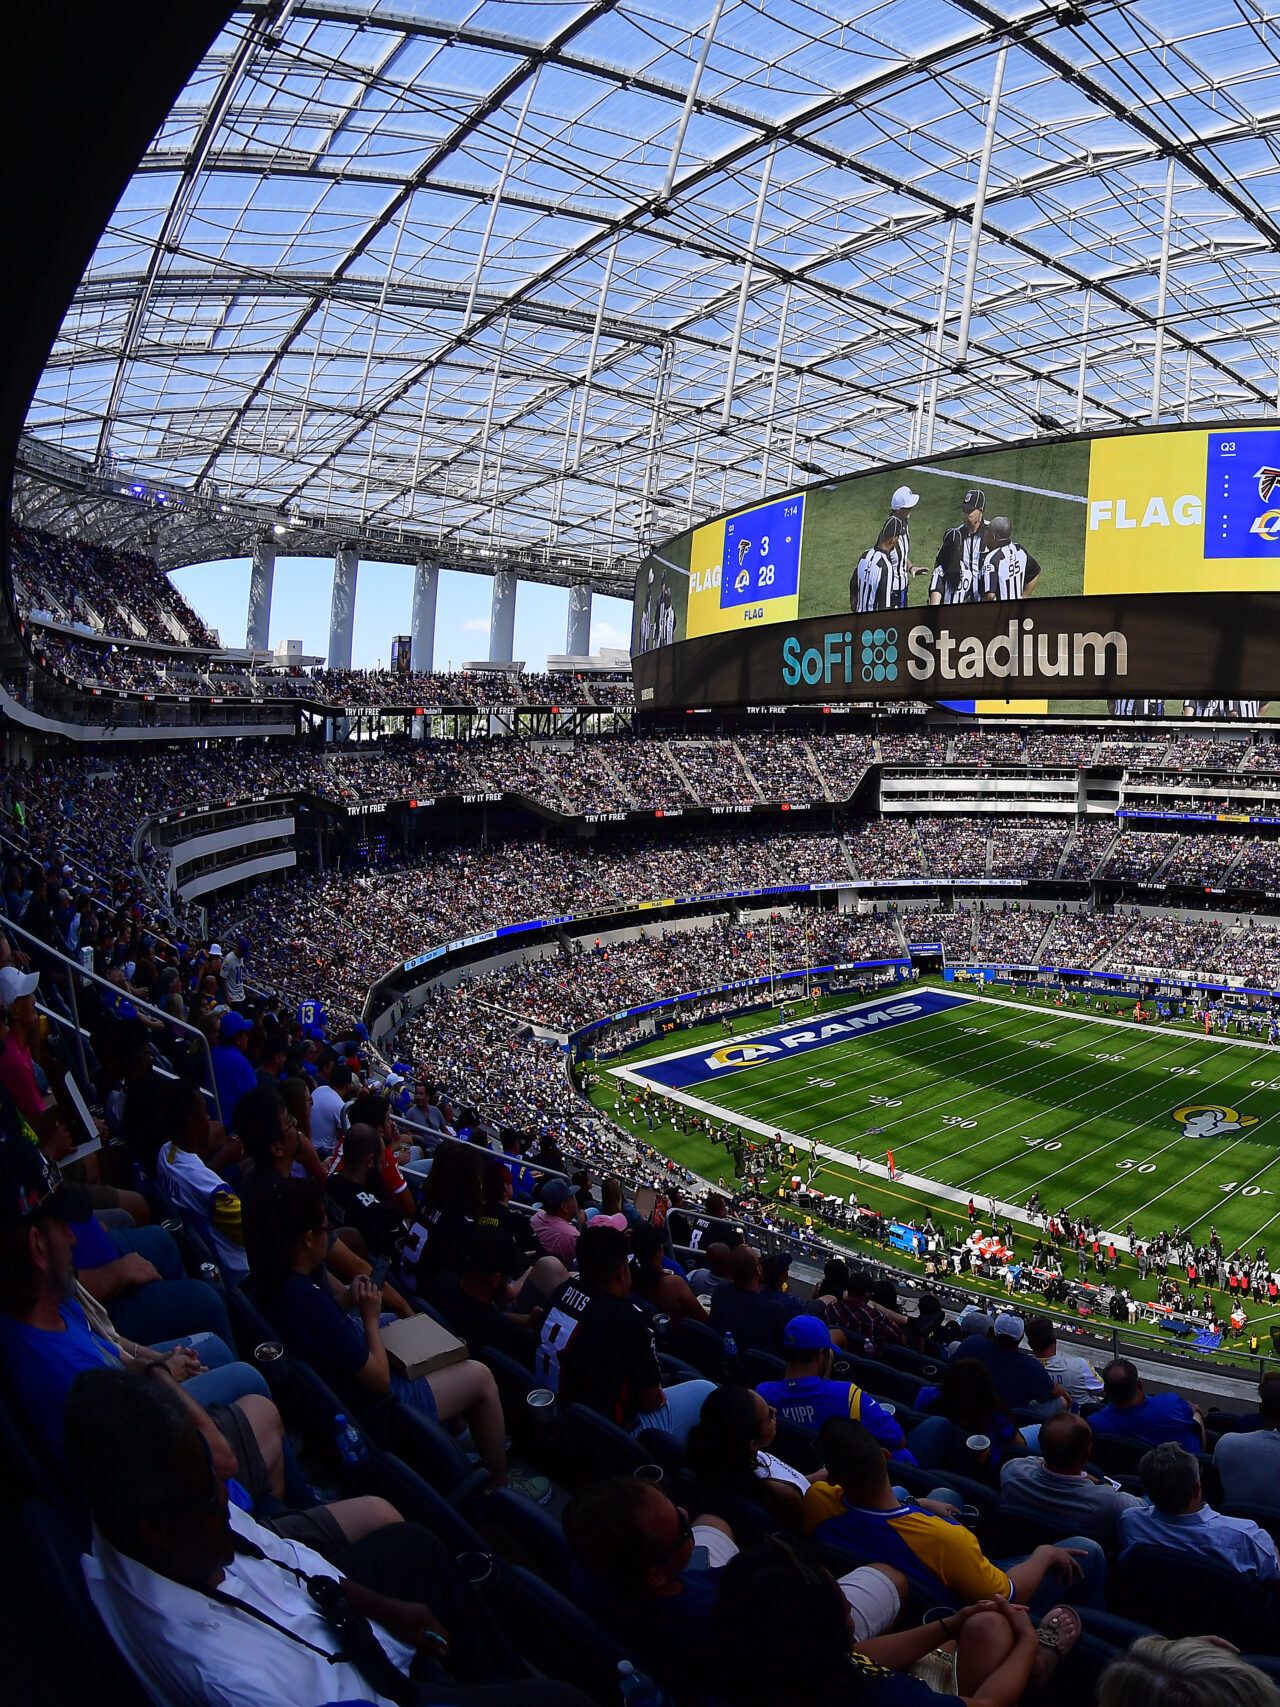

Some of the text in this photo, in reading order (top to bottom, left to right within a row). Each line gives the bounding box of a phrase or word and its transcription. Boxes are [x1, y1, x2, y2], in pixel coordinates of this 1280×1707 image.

[1220, 441, 1236, 452] Q3
[1089, 494, 1202, 531] FLAG
[760, 536, 769, 557] 3
[688, 564, 721, 595] FLAG
[758, 564, 775, 587] 28
[744, 608, 763, 620] FLAG
[782, 618, 1129, 686] SoFi Stadium
[345, 708, 356, 716] TRY
[357, 708, 364, 716] IT
[477, 707, 489, 715] TRY
[463, 795, 476, 804] TRY
[477, 794, 484, 803] IT
[348, 806, 361, 816] TRY
[361, 805, 368, 815] IT
[585, 814, 599, 823] TRY
[600, 813, 607, 822] IT
[711, 806, 725, 814] TRY
[728, 979, 760, 990] HOUSE
[1160, 979, 1197, 988] HOUSE
[301, 1006, 314, 1024] 13
[779, 1003, 922, 1049] RAMS
[943, 1115, 978, 1130] 30
[1021, 1135, 1063, 1152] 40
[1116, 1158, 1157, 1174] 50
[1218, 1181, 1262, 1197] 40
[696, 1219, 709, 1228] PITTS
[689, 1229, 702, 1249] 8
[561, 1286, 591, 1312] PITTS
[535, 1306, 580, 1394] 8
[782, 1405, 815, 1424] KUPP
